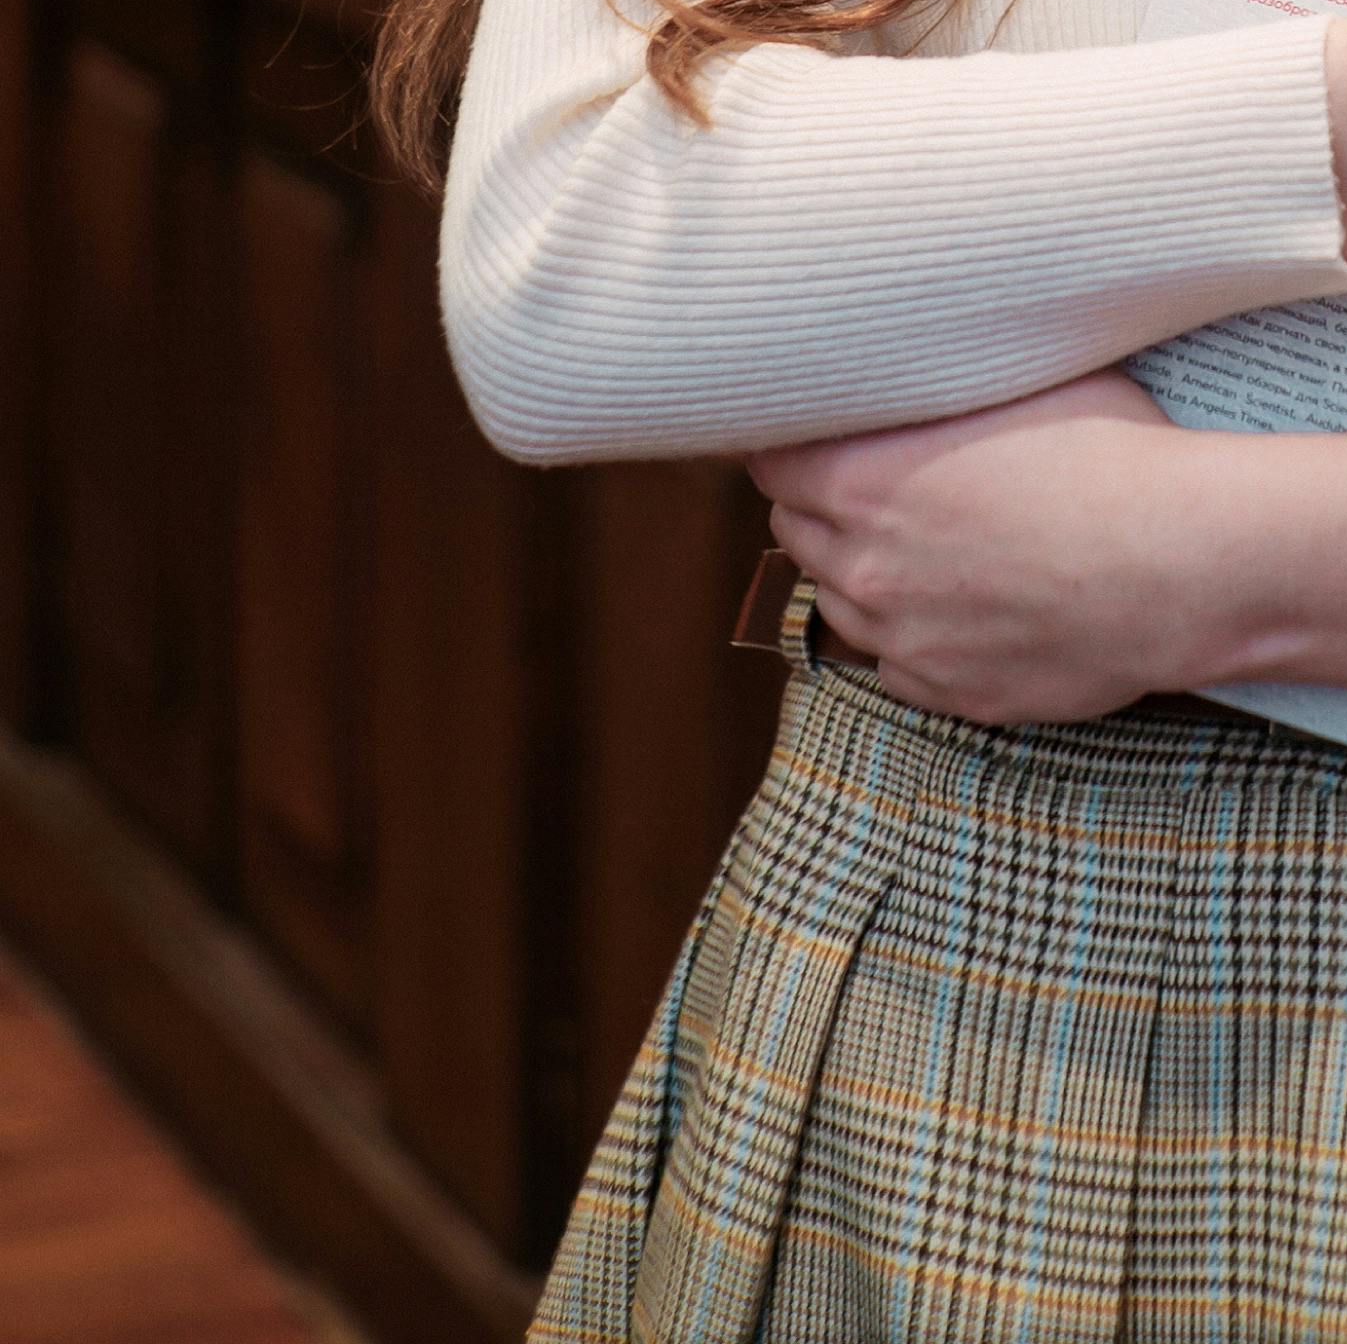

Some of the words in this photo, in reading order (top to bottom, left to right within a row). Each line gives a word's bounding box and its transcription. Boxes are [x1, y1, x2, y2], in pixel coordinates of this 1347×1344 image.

[1239, 314, 1260, 327] Как
[1263, 321, 1311, 344] догнать
[1315, 339, 1346, 354] свою
[1182, 373, 1237, 399] American
[1188, 358, 1243, 379] книжные
[1247, 376, 1291, 396] обзоры
[1296, 394, 1318, 406] для
[1167, 388, 1186, 404] Los
[1190, 396, 1237, 420] Angeles
